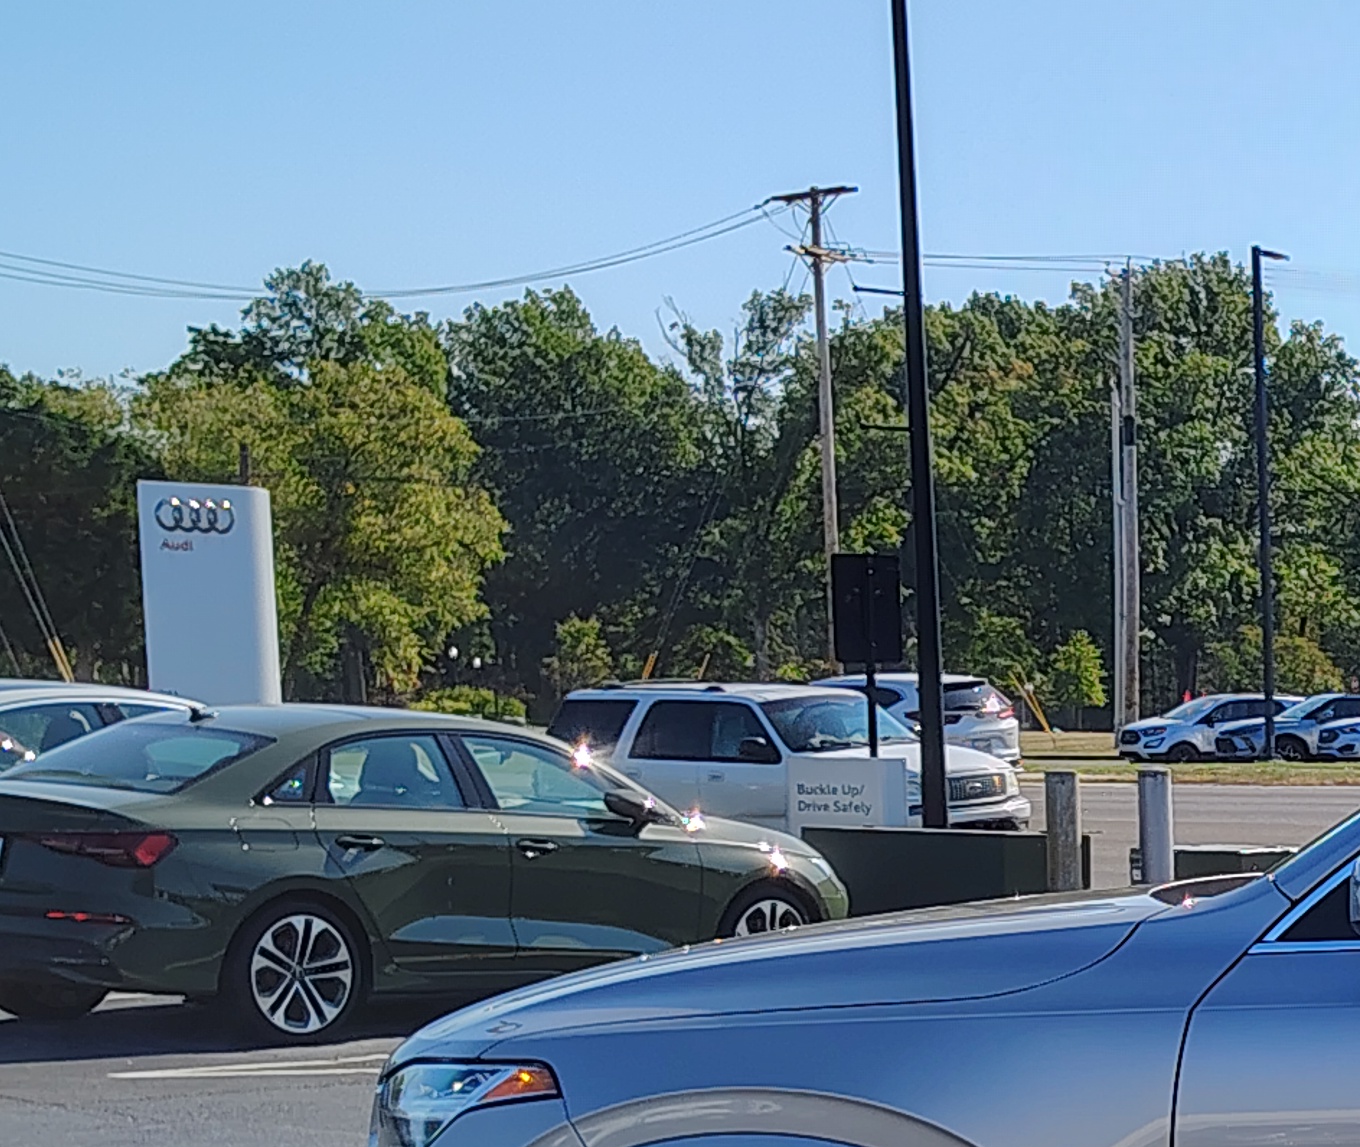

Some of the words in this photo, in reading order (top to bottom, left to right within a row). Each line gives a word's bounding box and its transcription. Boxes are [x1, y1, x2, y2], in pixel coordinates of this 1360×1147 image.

[160, 539, 193, 551] Audi
[797, 784, 838, 796] Buckle
[841, 784, 865, 798] Up/
[797, 800, 830, 812] Drive
[833, 800, 872, 816] Safely
